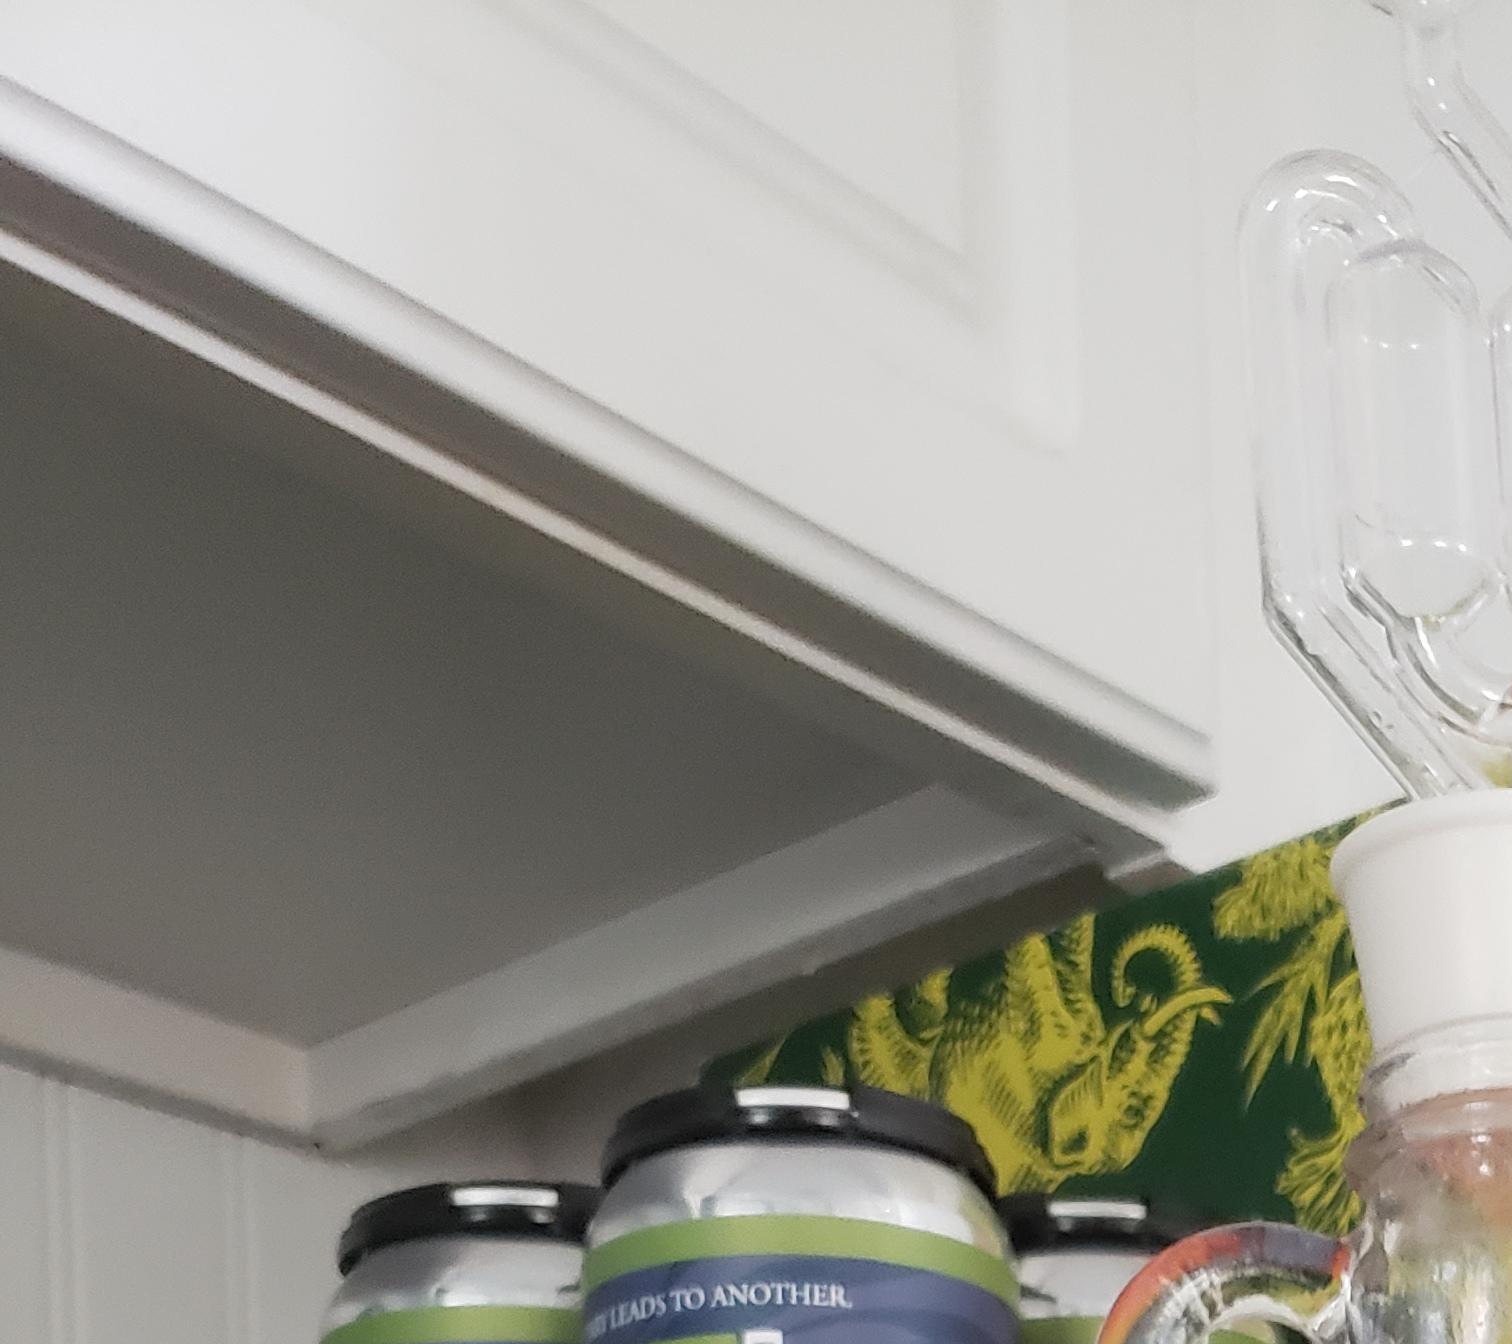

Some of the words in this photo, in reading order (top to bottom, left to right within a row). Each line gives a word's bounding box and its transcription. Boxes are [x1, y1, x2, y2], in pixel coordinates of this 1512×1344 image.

[610, 1294, 668, 1329] LEADS
[669, 1287, 706, 1313] TO
[710, 1281, 854, 1310] ANOTHER.
